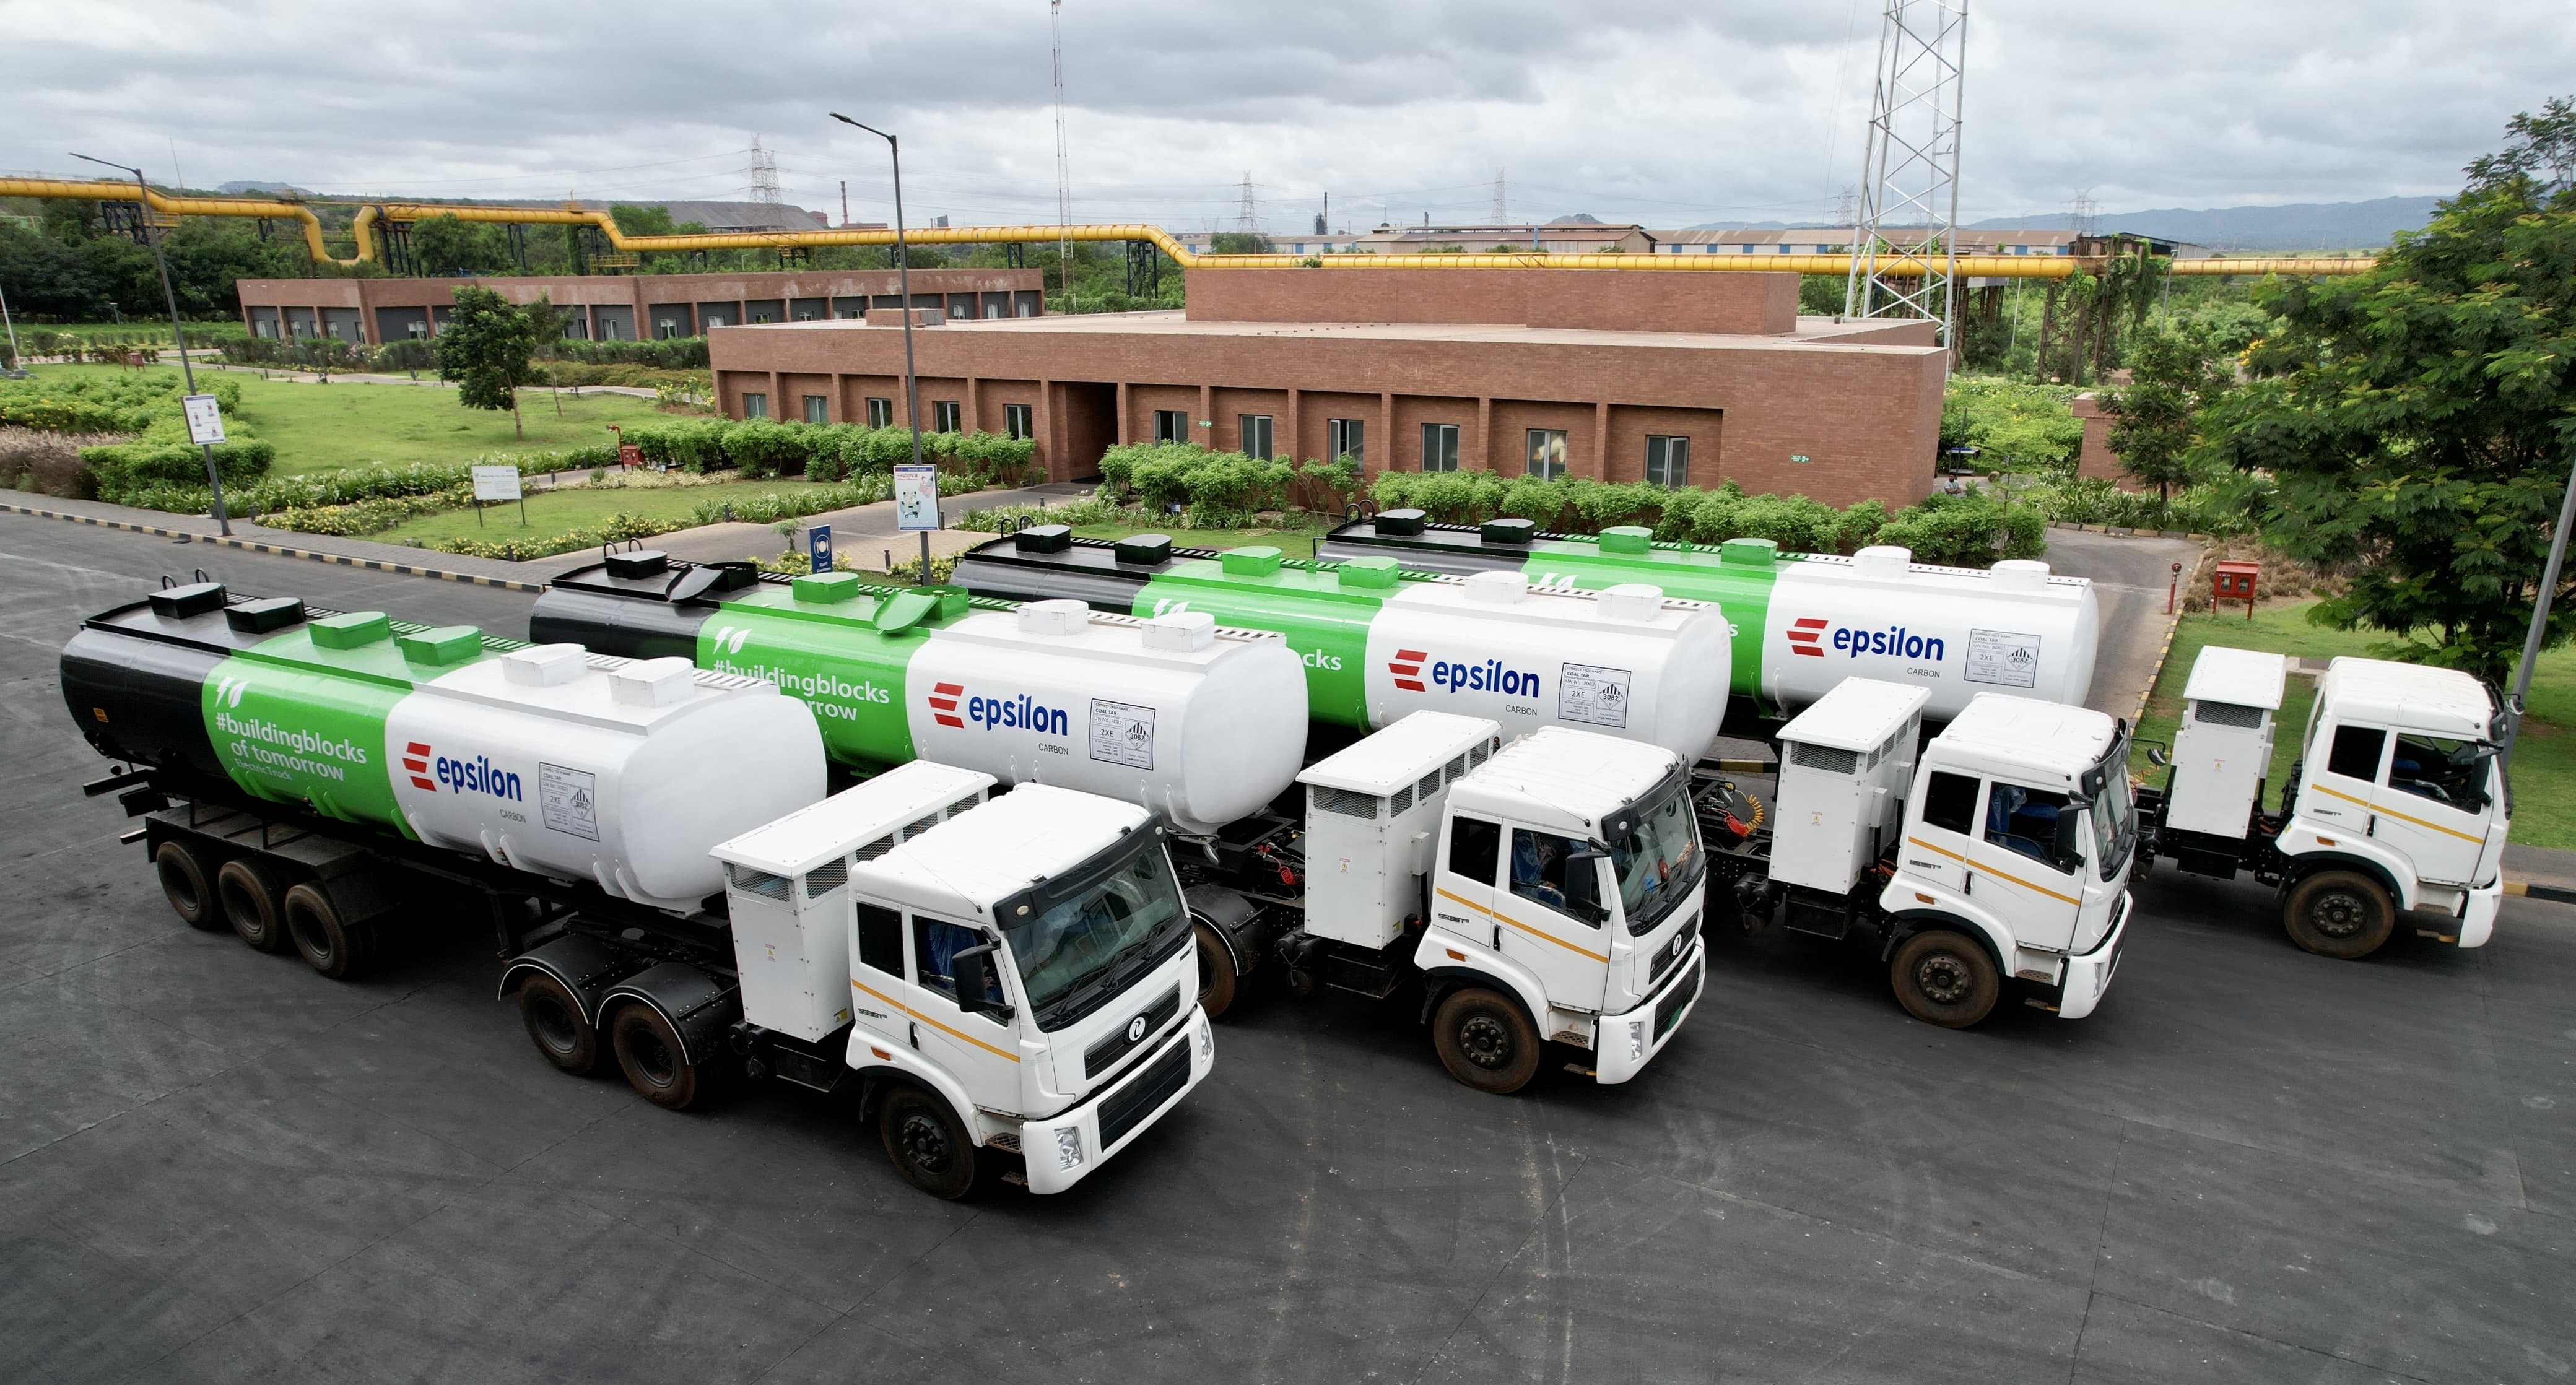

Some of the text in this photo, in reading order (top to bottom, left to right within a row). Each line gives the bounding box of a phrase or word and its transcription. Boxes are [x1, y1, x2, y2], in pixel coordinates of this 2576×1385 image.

[1833, 625, 1944, 661] epsilon
[1432, 659, 1539, 698] epsilon
[1907, 667, 1940, 678] CARBON
[1572, 690, 1585, 698] 2XE
[969, 693, 1068, 736] epsilon
[1505, 705, 1538, 716] CARBON
[215, 712, 367, 764] #buildingblocks
[1101, 729, 1113, 737] 2XE
[1130, 733, 1145, 741] 3082
[1038, 743, 1069, 755] CARBON
[230, 739, 344, 781] of tomorrow
[266, 766, 292, 781] Truck
[437, 755, 523, 802] epsilon
[550, 796, 561, 804] 2XE
[575, 801, 588, 810] 3082
[500, 809, 526, 823] CARBON
